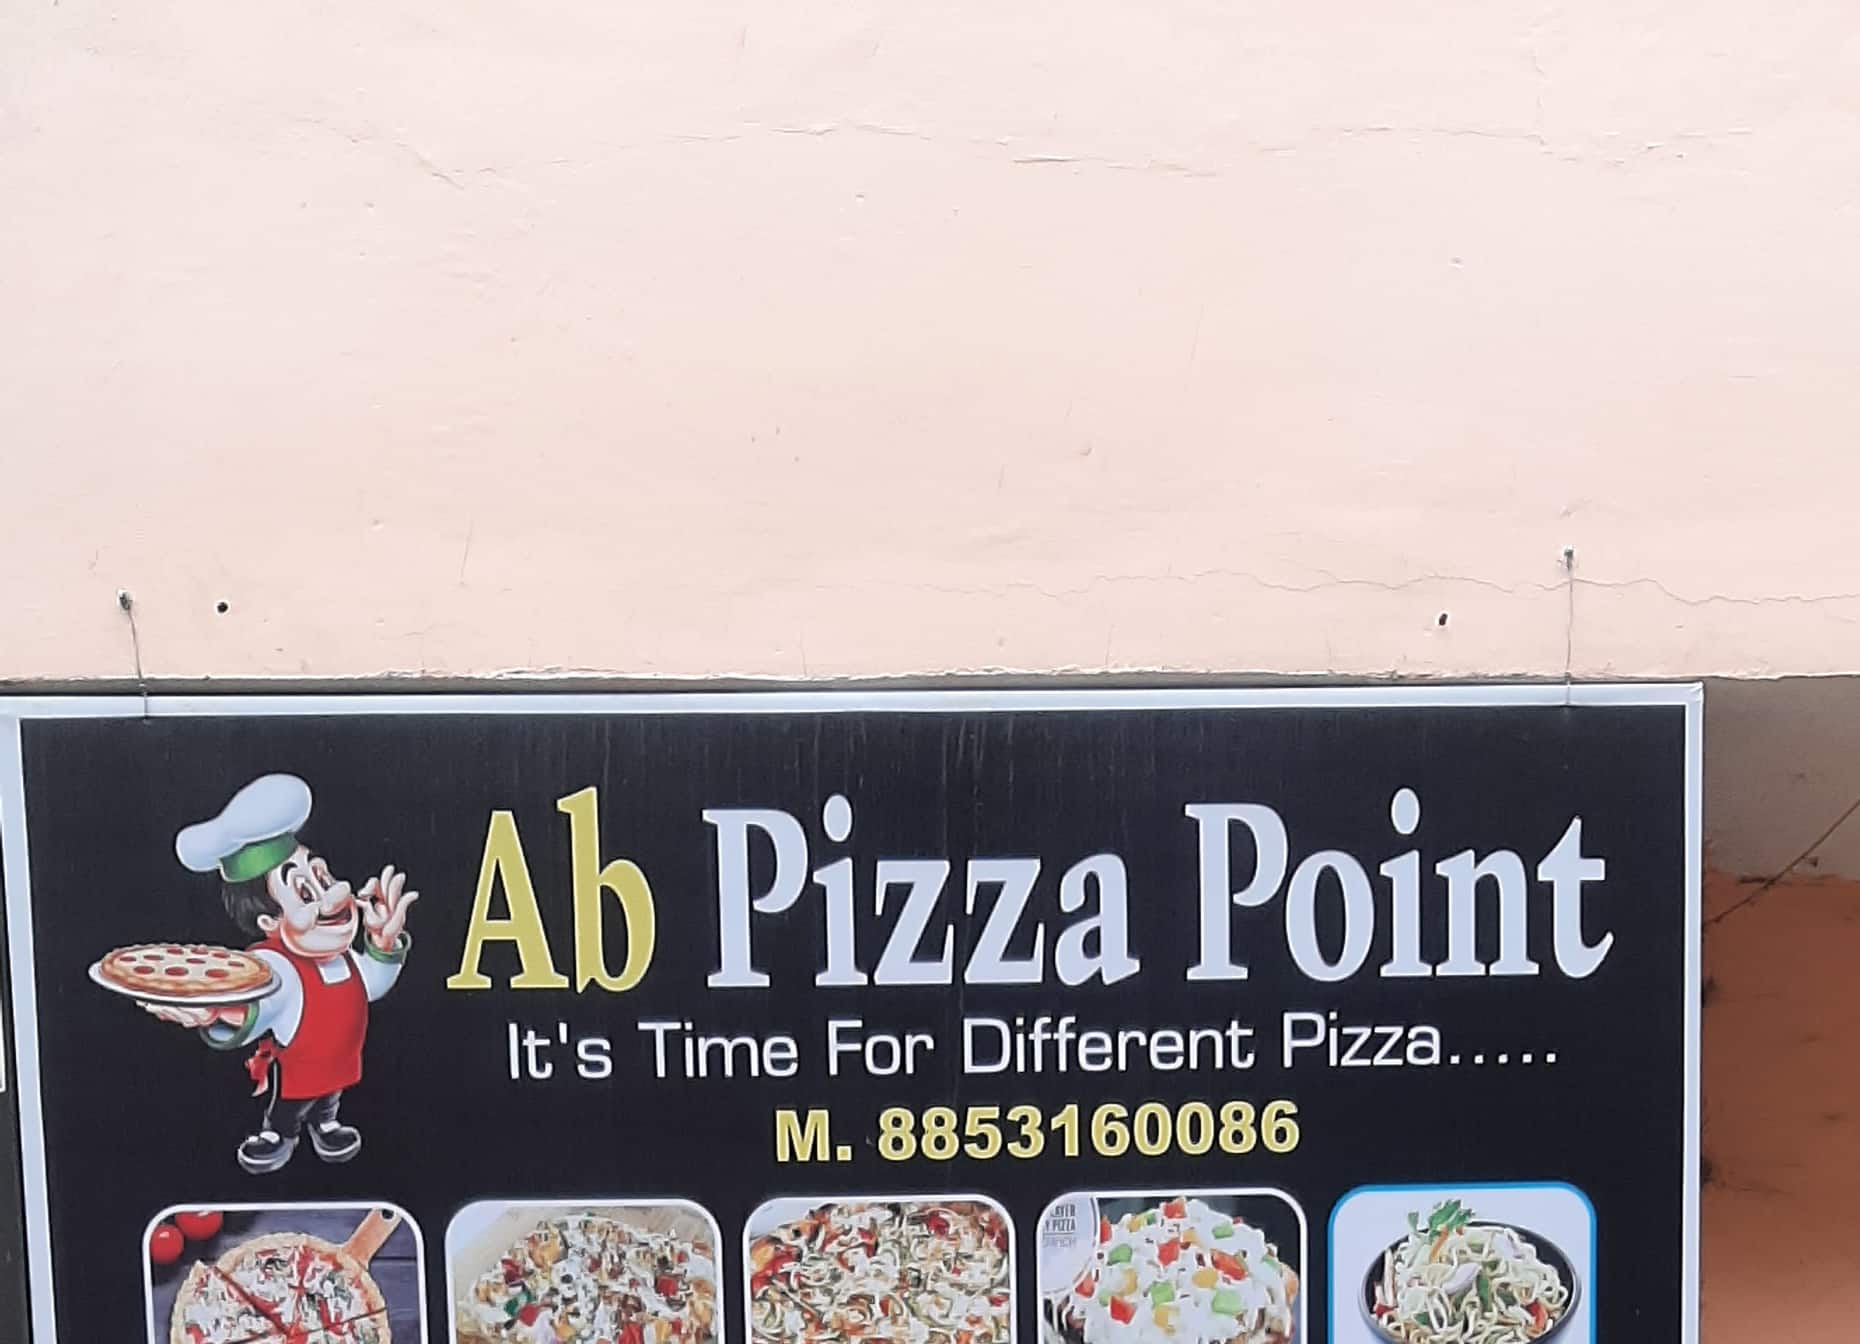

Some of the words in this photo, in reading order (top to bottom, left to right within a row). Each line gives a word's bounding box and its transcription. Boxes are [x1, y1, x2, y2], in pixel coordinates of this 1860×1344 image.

[447, 786, 656, 993] Ab
[702, 795, 1139, 988] Pizza
[1185, 787, 1614, 982] Point
[508, 1021, 611, 1080] It's
[638, 1019, 800, 1078] Time
[828, 1019, 934, 1076] For
[963, 1014, 1256, 1073] Different
[775, 1110, 852, 1162] M.
[878, 1100, 1300, 1160] 8853160086
